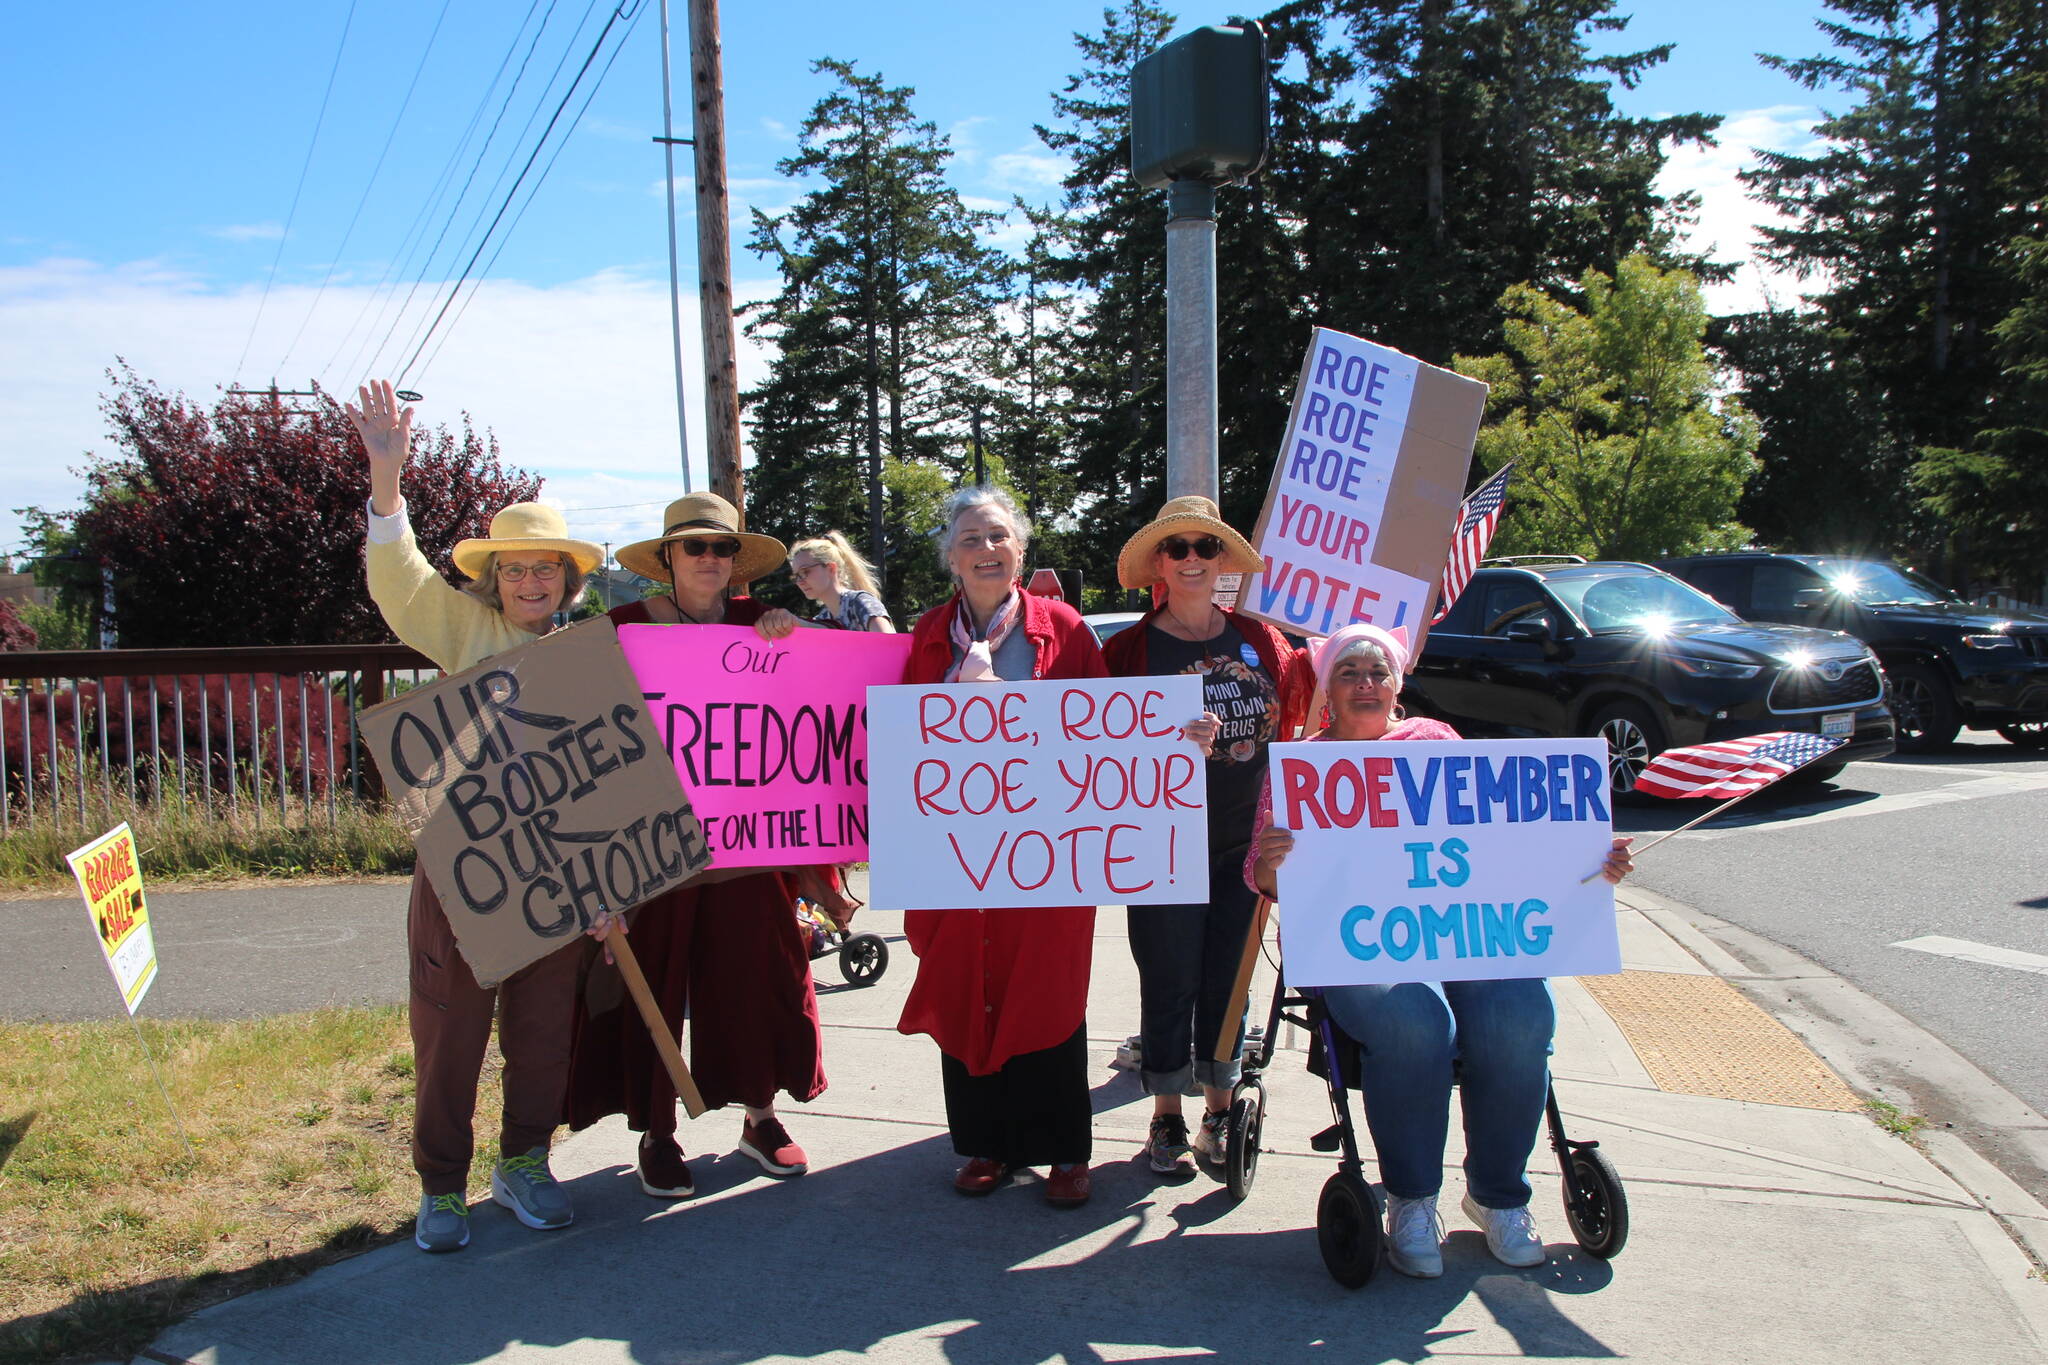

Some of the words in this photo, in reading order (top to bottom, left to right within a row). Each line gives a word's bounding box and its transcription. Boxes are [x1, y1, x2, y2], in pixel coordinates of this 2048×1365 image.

[1315, 346, 1390, 406] ROE
[1302, 392, 1379, 453] ROE
[1289, 440, 1366, 501] ROE
[1279, 494, 1370, 565] YOUR
[722, 641, 790, 674] Our
[919, 692, 1039, 747] ROE,
[1060, 689, 1185, 741] ROE,
[1205, 681, 1241, 701] MIND
[1231, 696, 1266, 718] OWN
[391, 670, 576, 789] OUR
[643, 692, 867, 787] REEDOM
[445, 704, 646, 841] BODIES
[913, 758, 1037, 816] ROE
[1057, 753, 1204, 813] YOUR
[1281, 754, 1610, 830] ROEVEMBER
[722, 813, 757, 850] ON
[763, 809, 810, 848] THE
[815, 803, 868, 848] LIN
[83, 836, 134, 904] GARAGE
[454, 809, 618, 915] OUR
[522, 804, 711, 938] CHOICE
[948, 824, 1175, 894] VOTE!
[1404, 837, 1470, 888] IS
[106, 888, 134, 942] SALE
[1340, 898, 1553, 962] COMING
